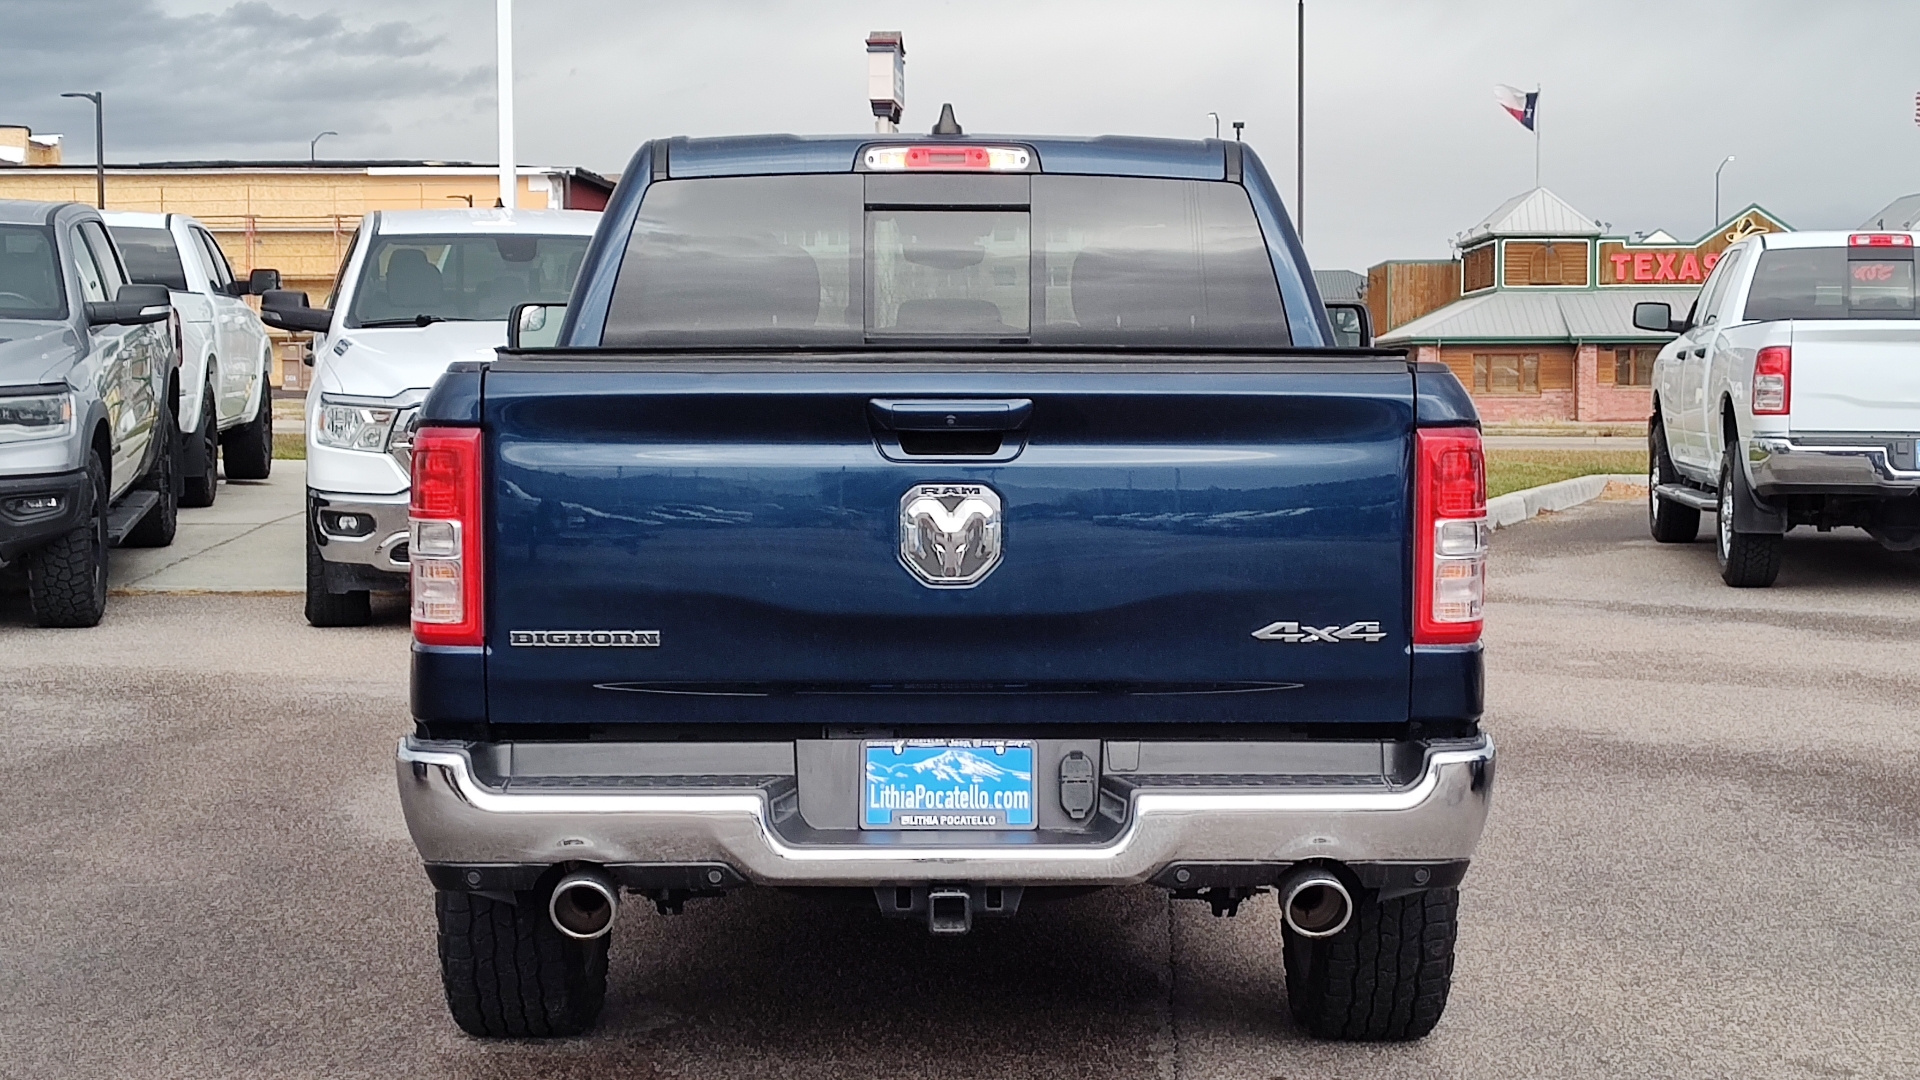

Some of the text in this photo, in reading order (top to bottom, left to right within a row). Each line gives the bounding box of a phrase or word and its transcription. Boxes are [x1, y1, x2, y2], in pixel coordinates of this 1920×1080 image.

[921, 487, 980, 495] RAM
[509, 630, 660, 647] BIGHORN
[1251, 621, 1387, 642] 4x4
[871, 784, 1029, 809] LithiaPocatello.com
[940, 816, 996, 826] POCATELLO
